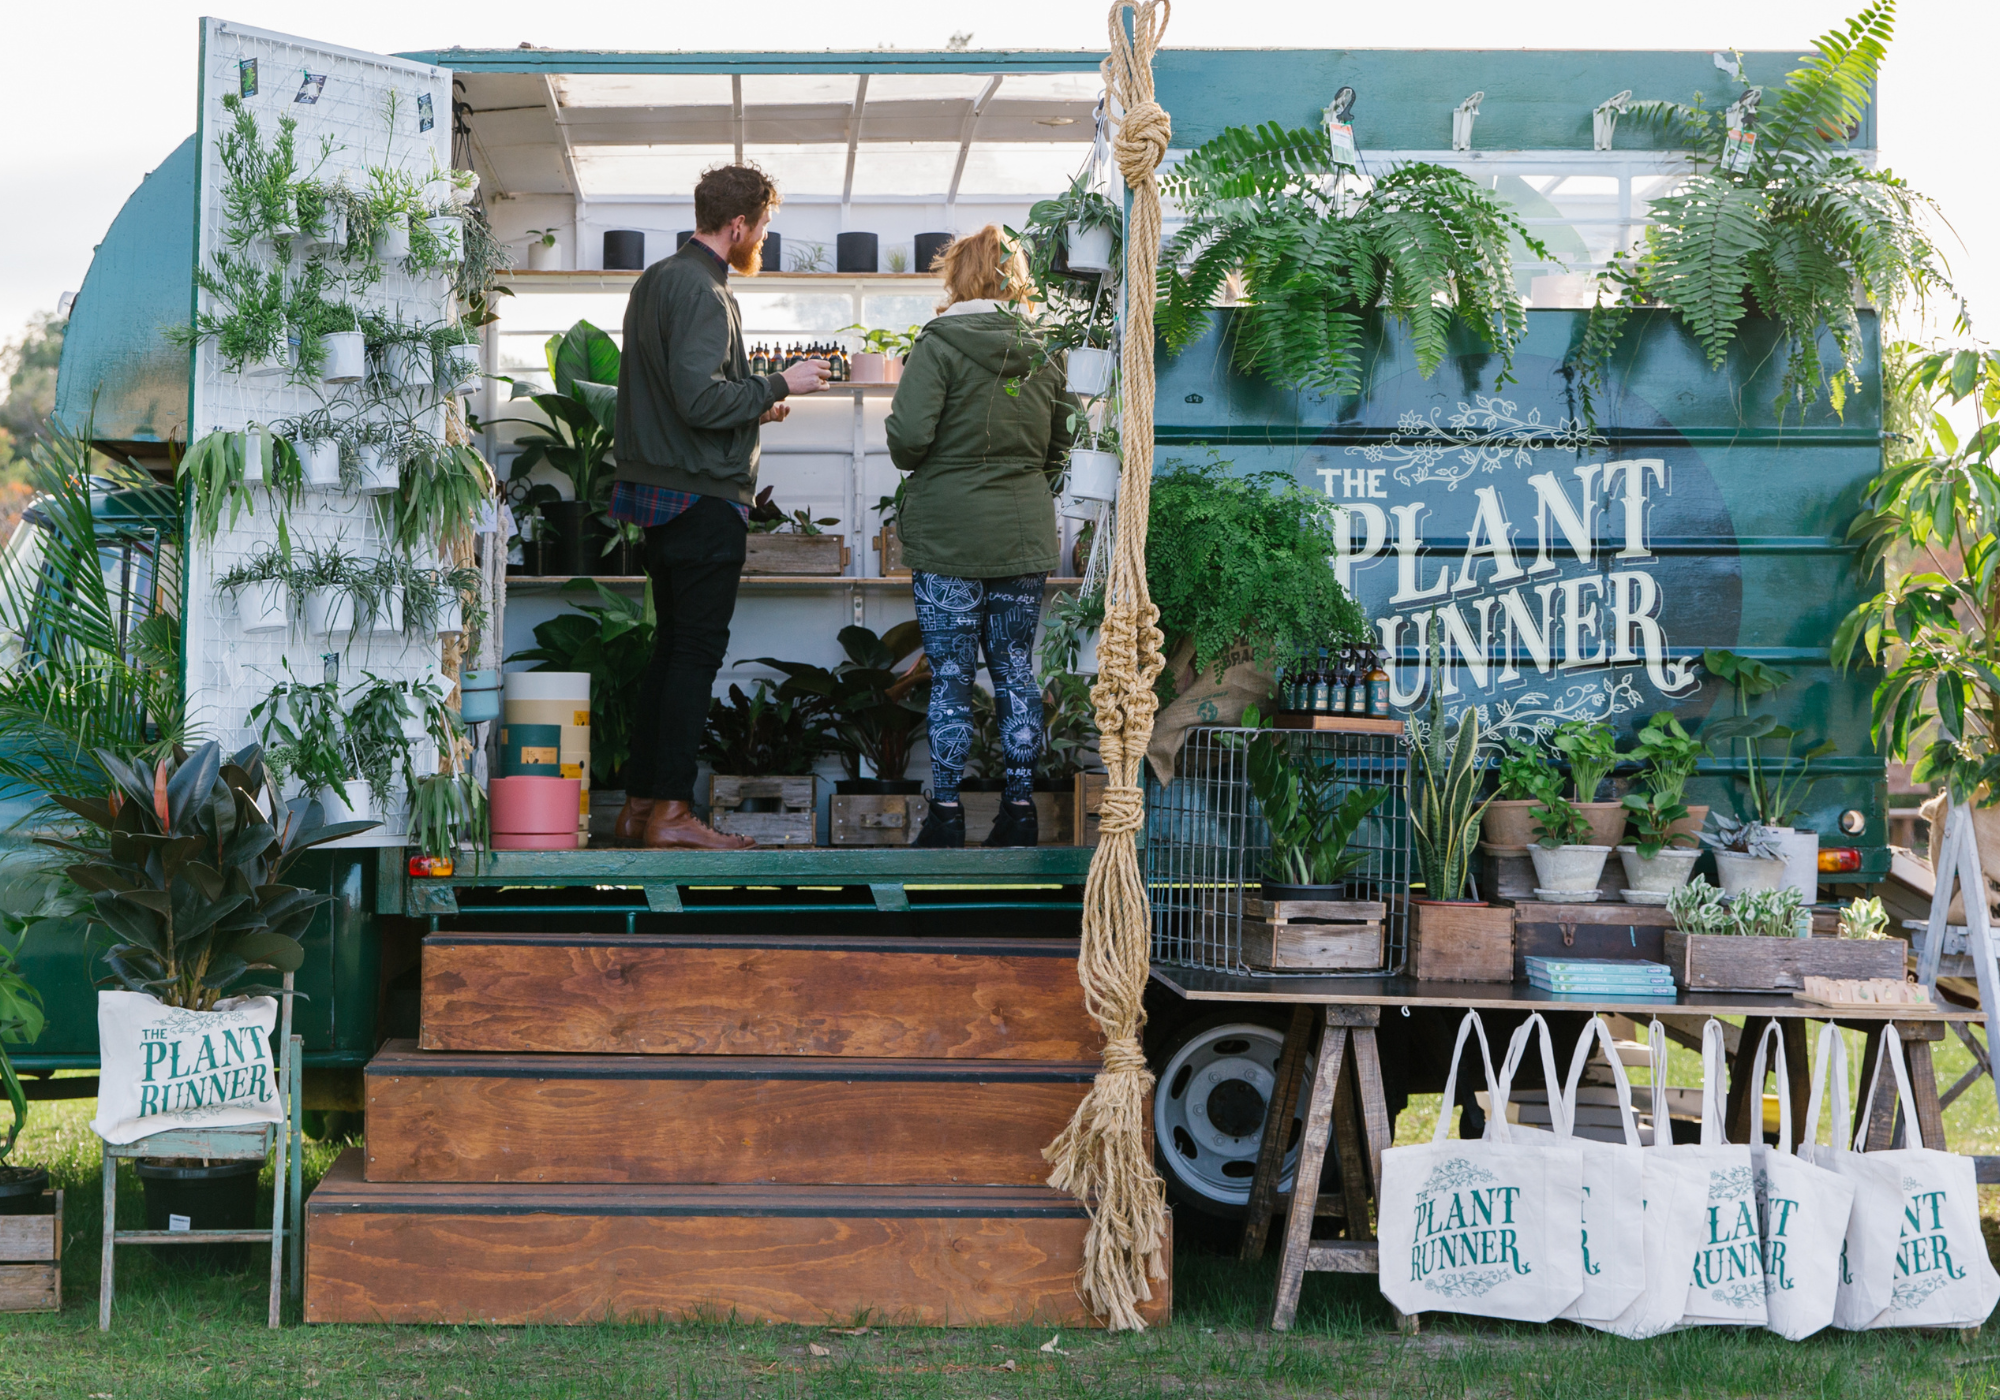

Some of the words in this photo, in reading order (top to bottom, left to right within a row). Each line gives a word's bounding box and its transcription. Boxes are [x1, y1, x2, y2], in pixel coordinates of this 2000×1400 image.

[1316, 467, 1388, 499] THE
[1330, 458, 1672, 608] PLANT
[1372, 570, 1700, 708] UNNER
[139, 1025, 266, 1083] PLANT
[142, 1028, 168, 1040] THE
[137, 1063, 274, 1118] RUNNER
[1413, 1186, 1521, 1244] PLANT
[1416, 1189, 1430, 1204] THE
[1410, 1228, 1532, 1282] RUNNER
